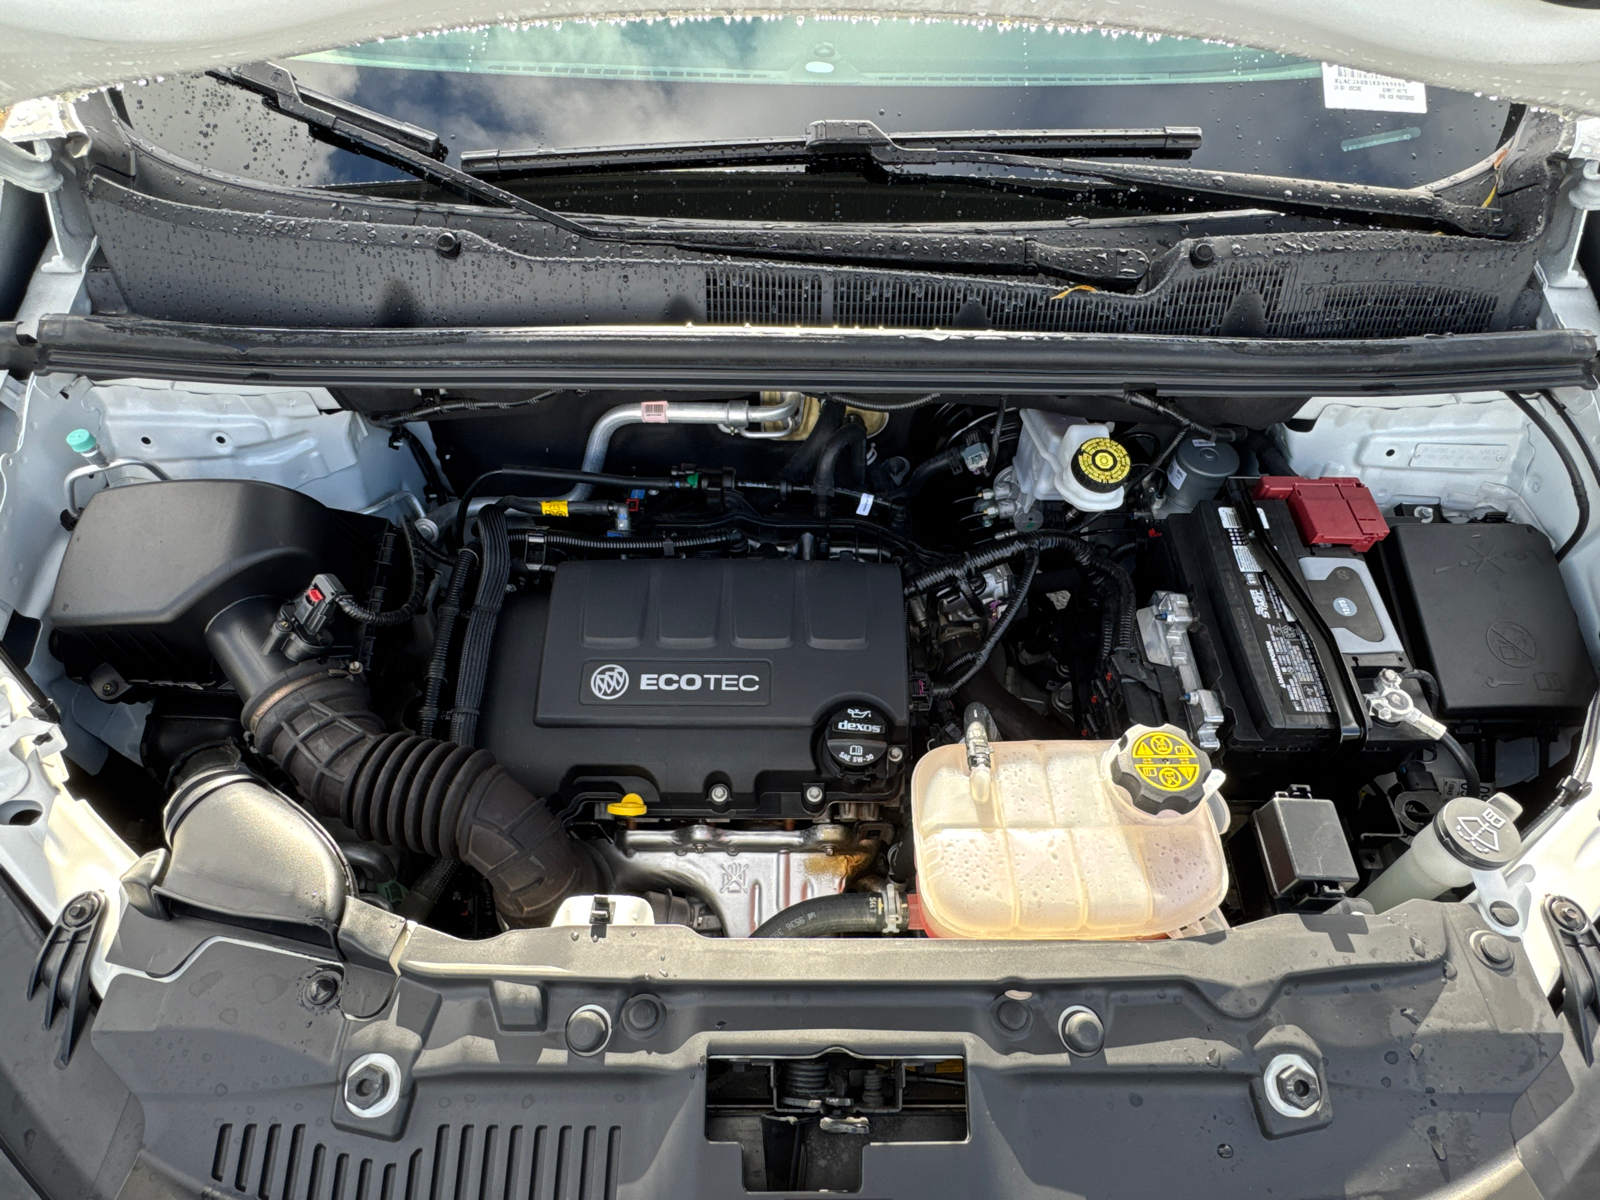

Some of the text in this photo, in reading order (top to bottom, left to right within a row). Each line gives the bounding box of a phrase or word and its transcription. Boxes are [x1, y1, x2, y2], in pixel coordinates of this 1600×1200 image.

[639, 673, 760, 692] ECOTEC
[838, 720, 882, 733] dexos
[838, 751, 875, 763] SAE 5W-30
[785, 916, 806, 931] 9536
